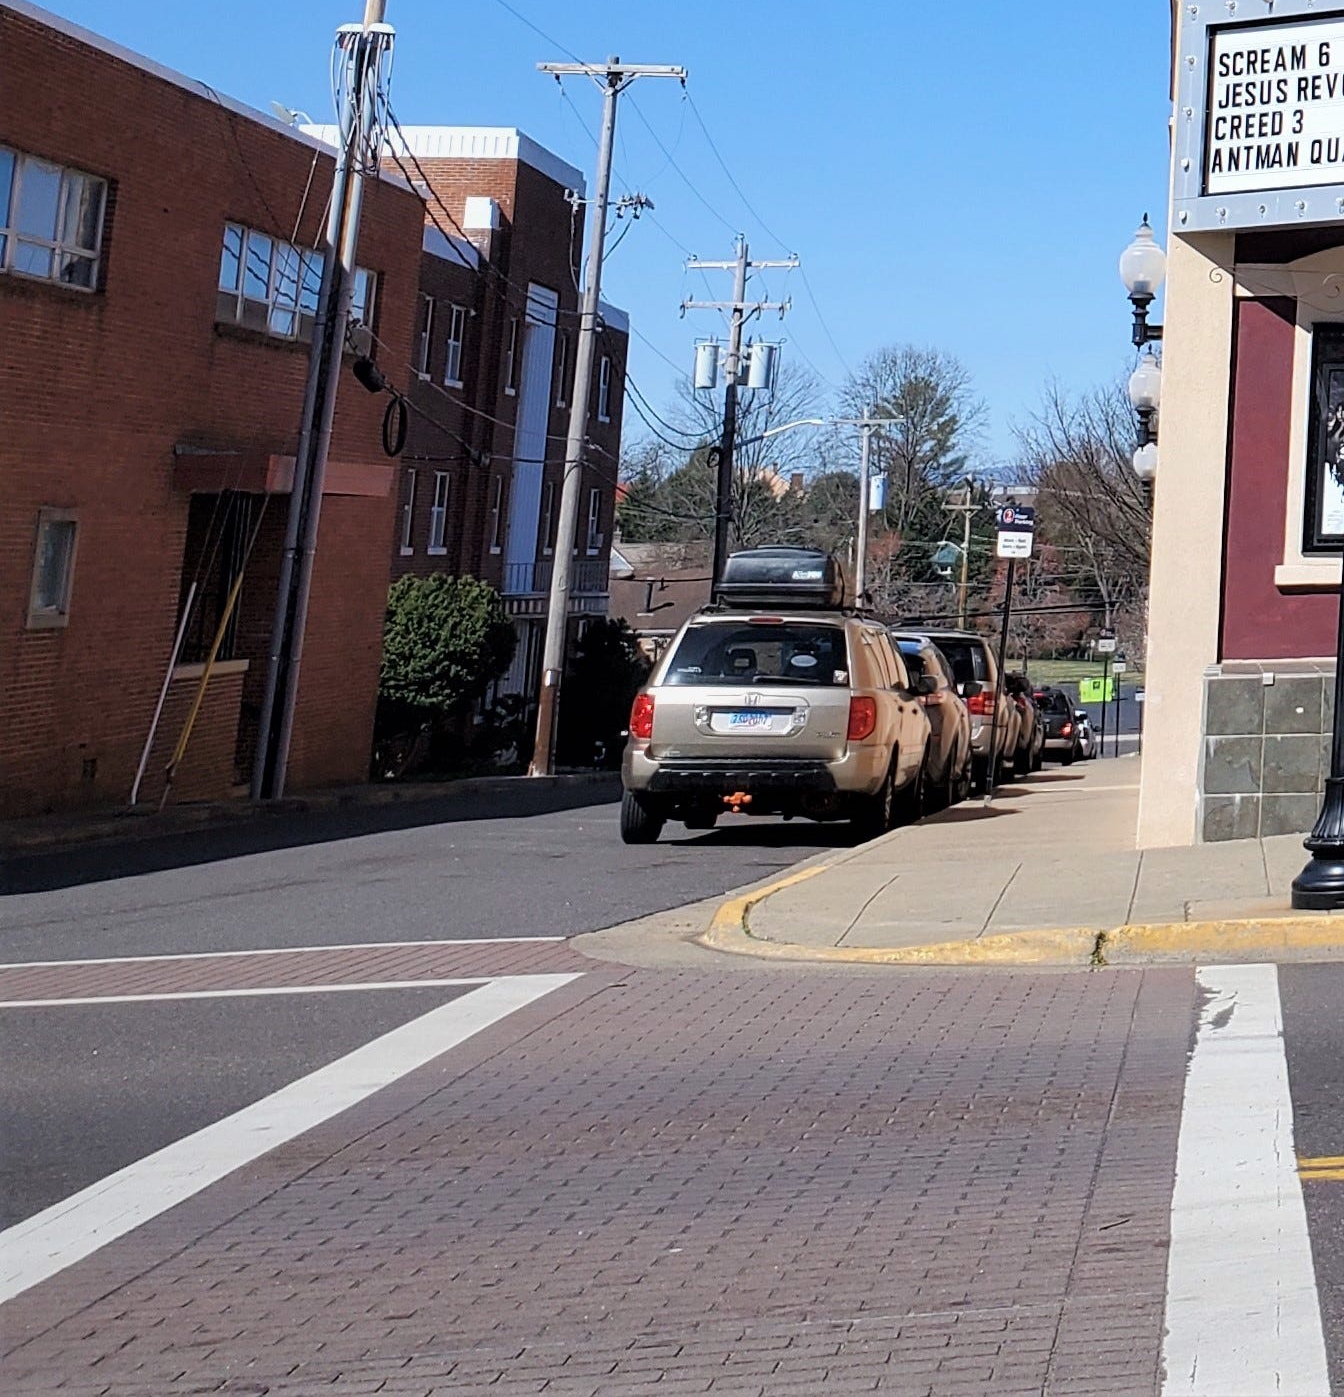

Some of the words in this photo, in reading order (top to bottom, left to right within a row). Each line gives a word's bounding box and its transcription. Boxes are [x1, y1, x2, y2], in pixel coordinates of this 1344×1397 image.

[1219, 44, 1307, 77] SCREAM
[1318, 42, 1331, 67] 6
[1218, 78, 1289, 109] JESUS
[1215, 111, 1284, 141] CREED
[1292, 109, 1304, 134] 3
[1211, 141, 1300, 174] ANTMAN
